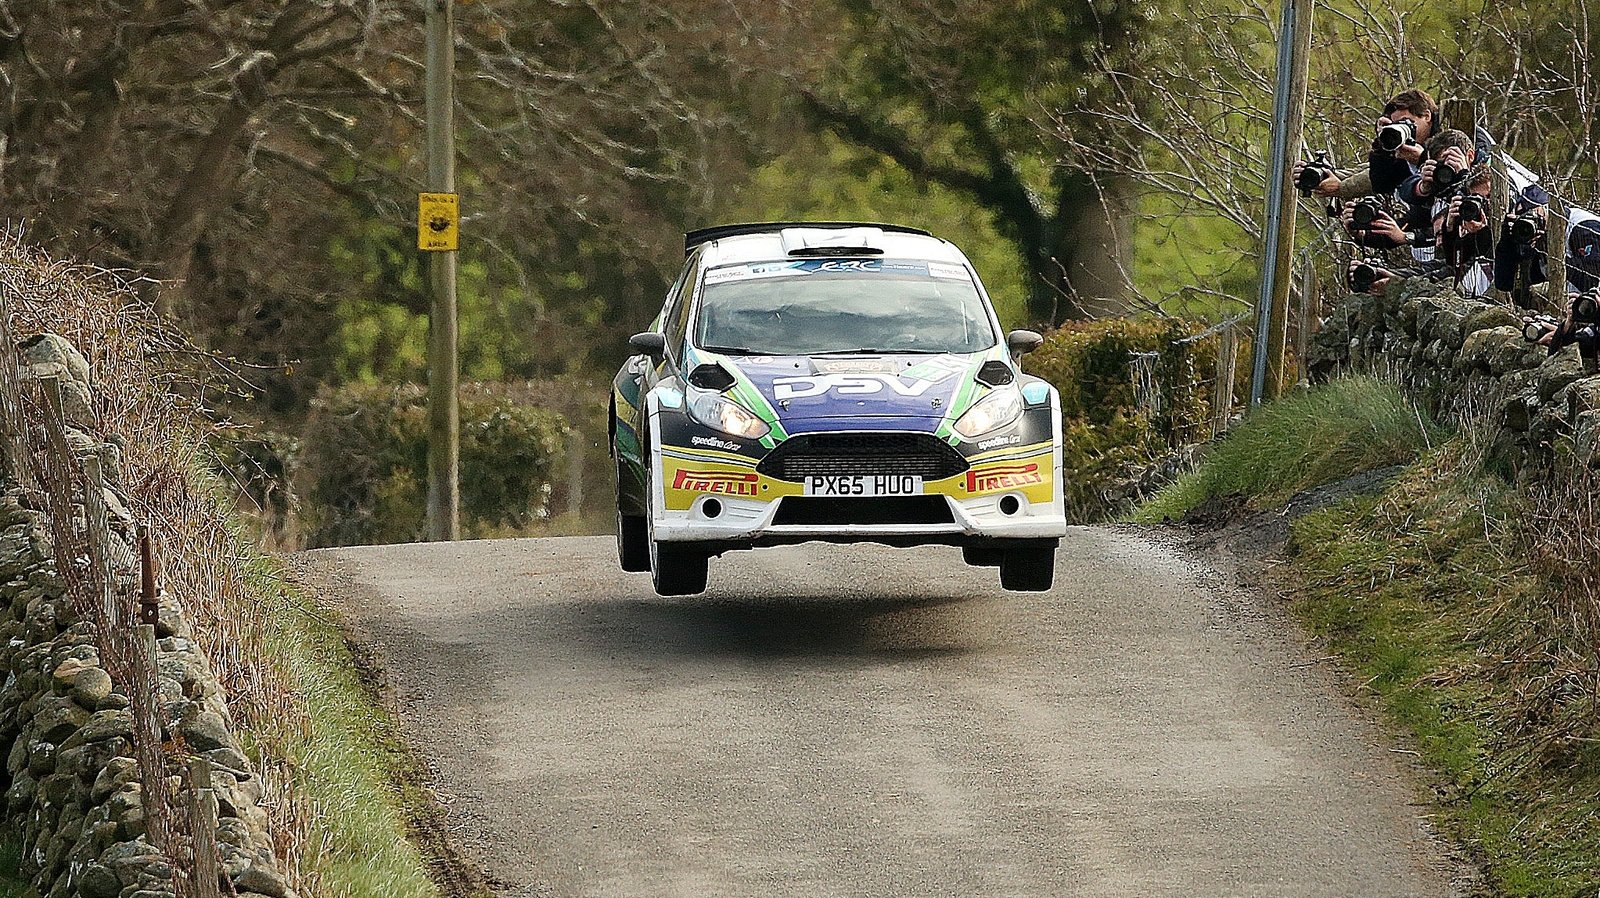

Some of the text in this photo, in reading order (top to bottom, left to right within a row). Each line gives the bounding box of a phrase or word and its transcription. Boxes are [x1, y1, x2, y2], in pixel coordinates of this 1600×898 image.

[821, 260, 881, 272] ERC
[772, 373, 937, 400] DSV
[672, 469, 759, 496] PIRELLI
[812, 475, 864, 495] PX65
[966, 463, 1042, 493] PIRELLI
